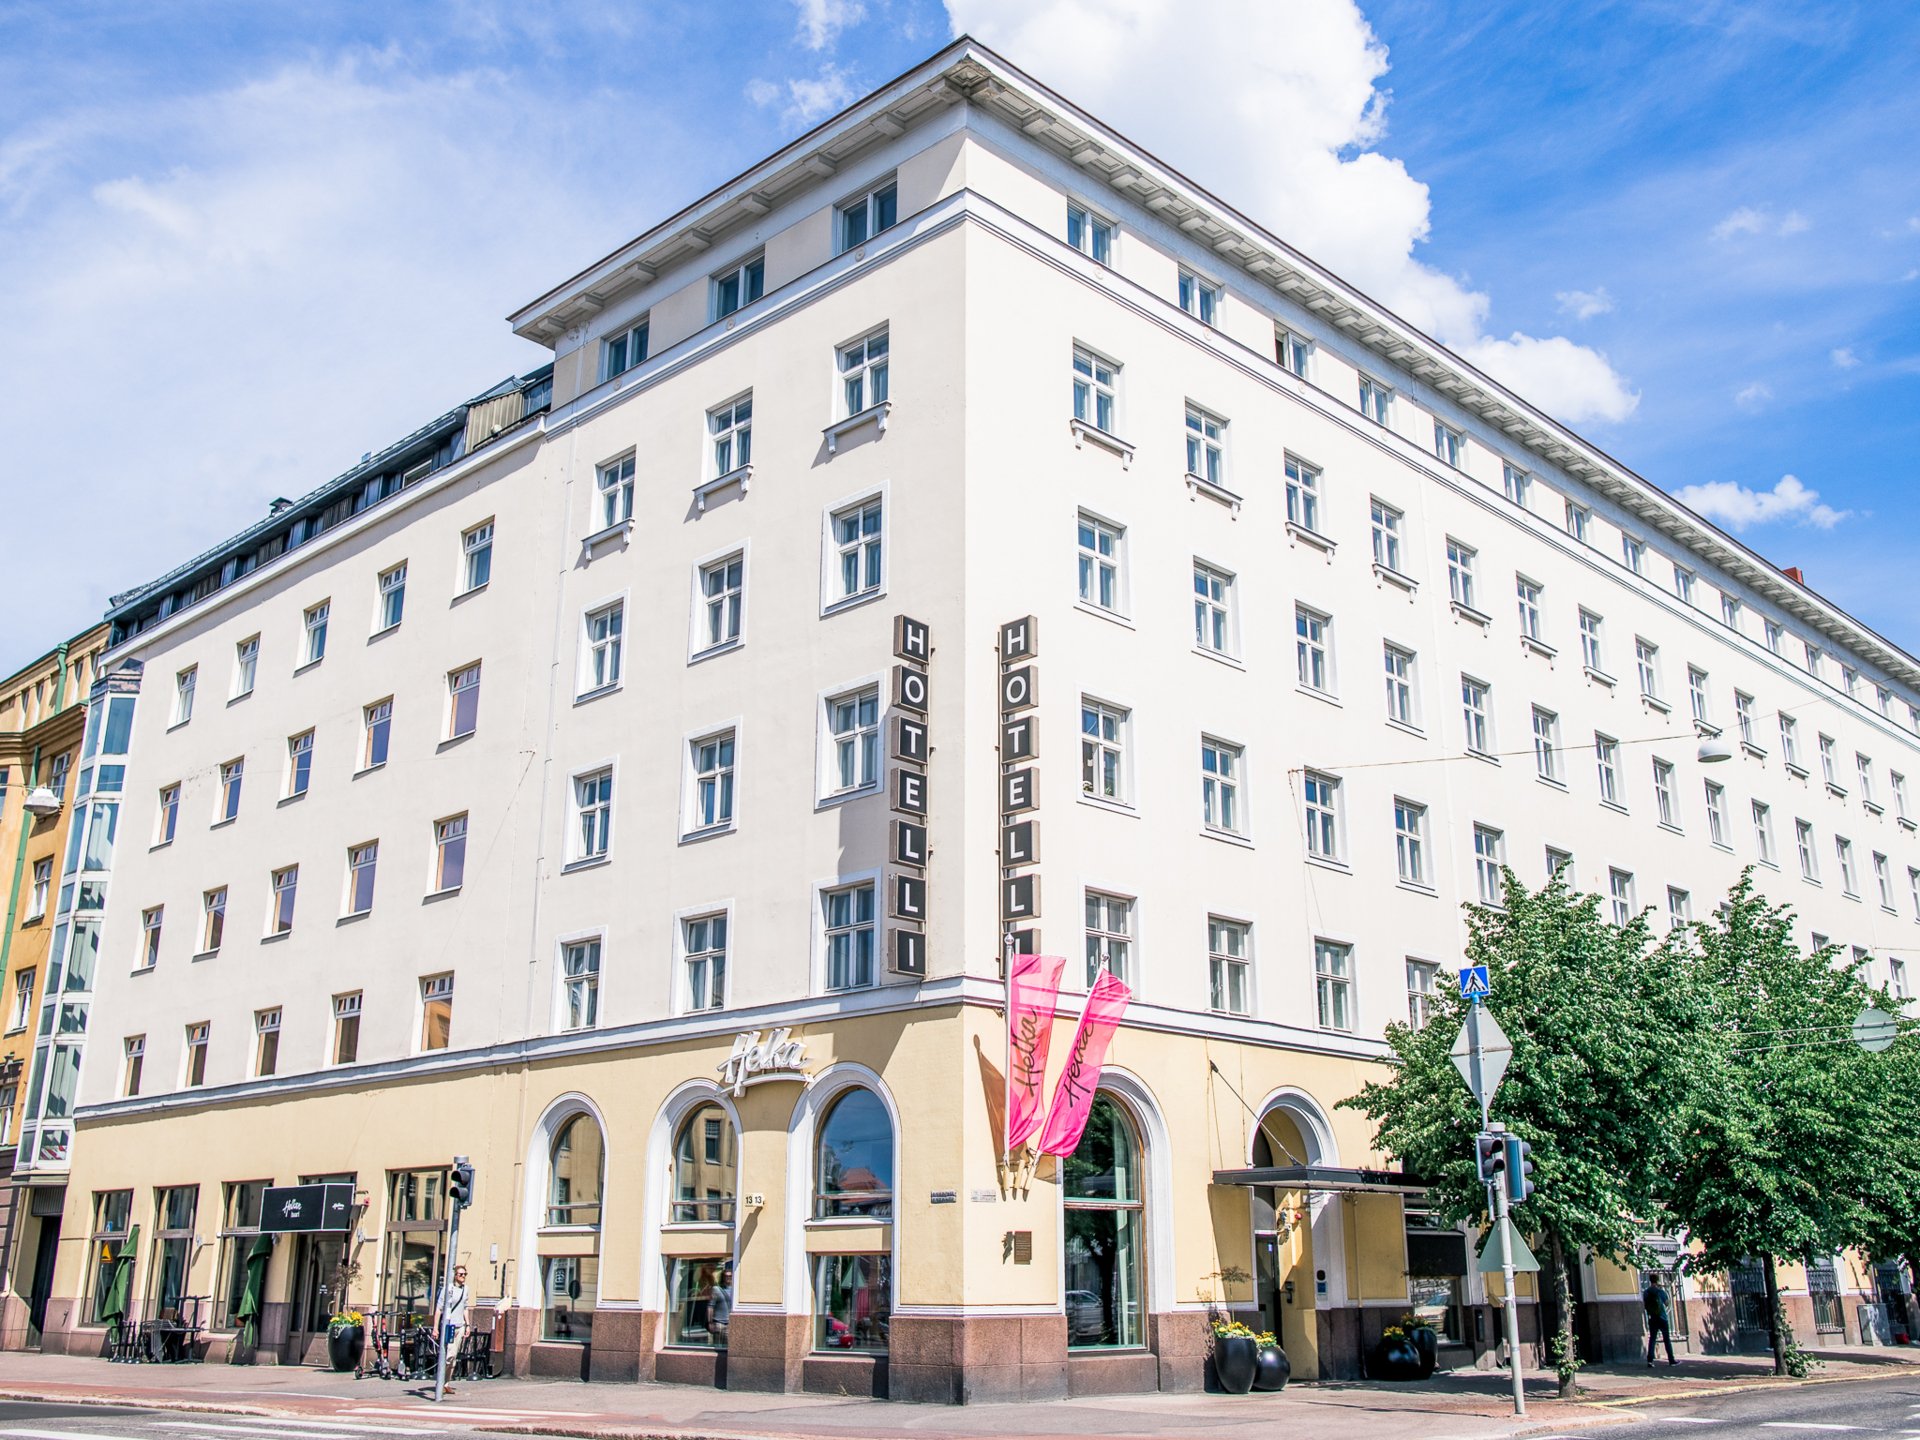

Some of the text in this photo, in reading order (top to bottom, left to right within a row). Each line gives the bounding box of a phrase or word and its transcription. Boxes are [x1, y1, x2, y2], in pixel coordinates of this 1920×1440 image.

[904, 622, 925, 967] HOTELLI
[1005, 623, 1027, 967] HOTELLI
[716, 1027, 814, 1098] Helka
[1012, 1007, 1043, 1097] Helka
[745, 1195, 752, 1204] 13
[755, 1195, 762, 1204] 13
